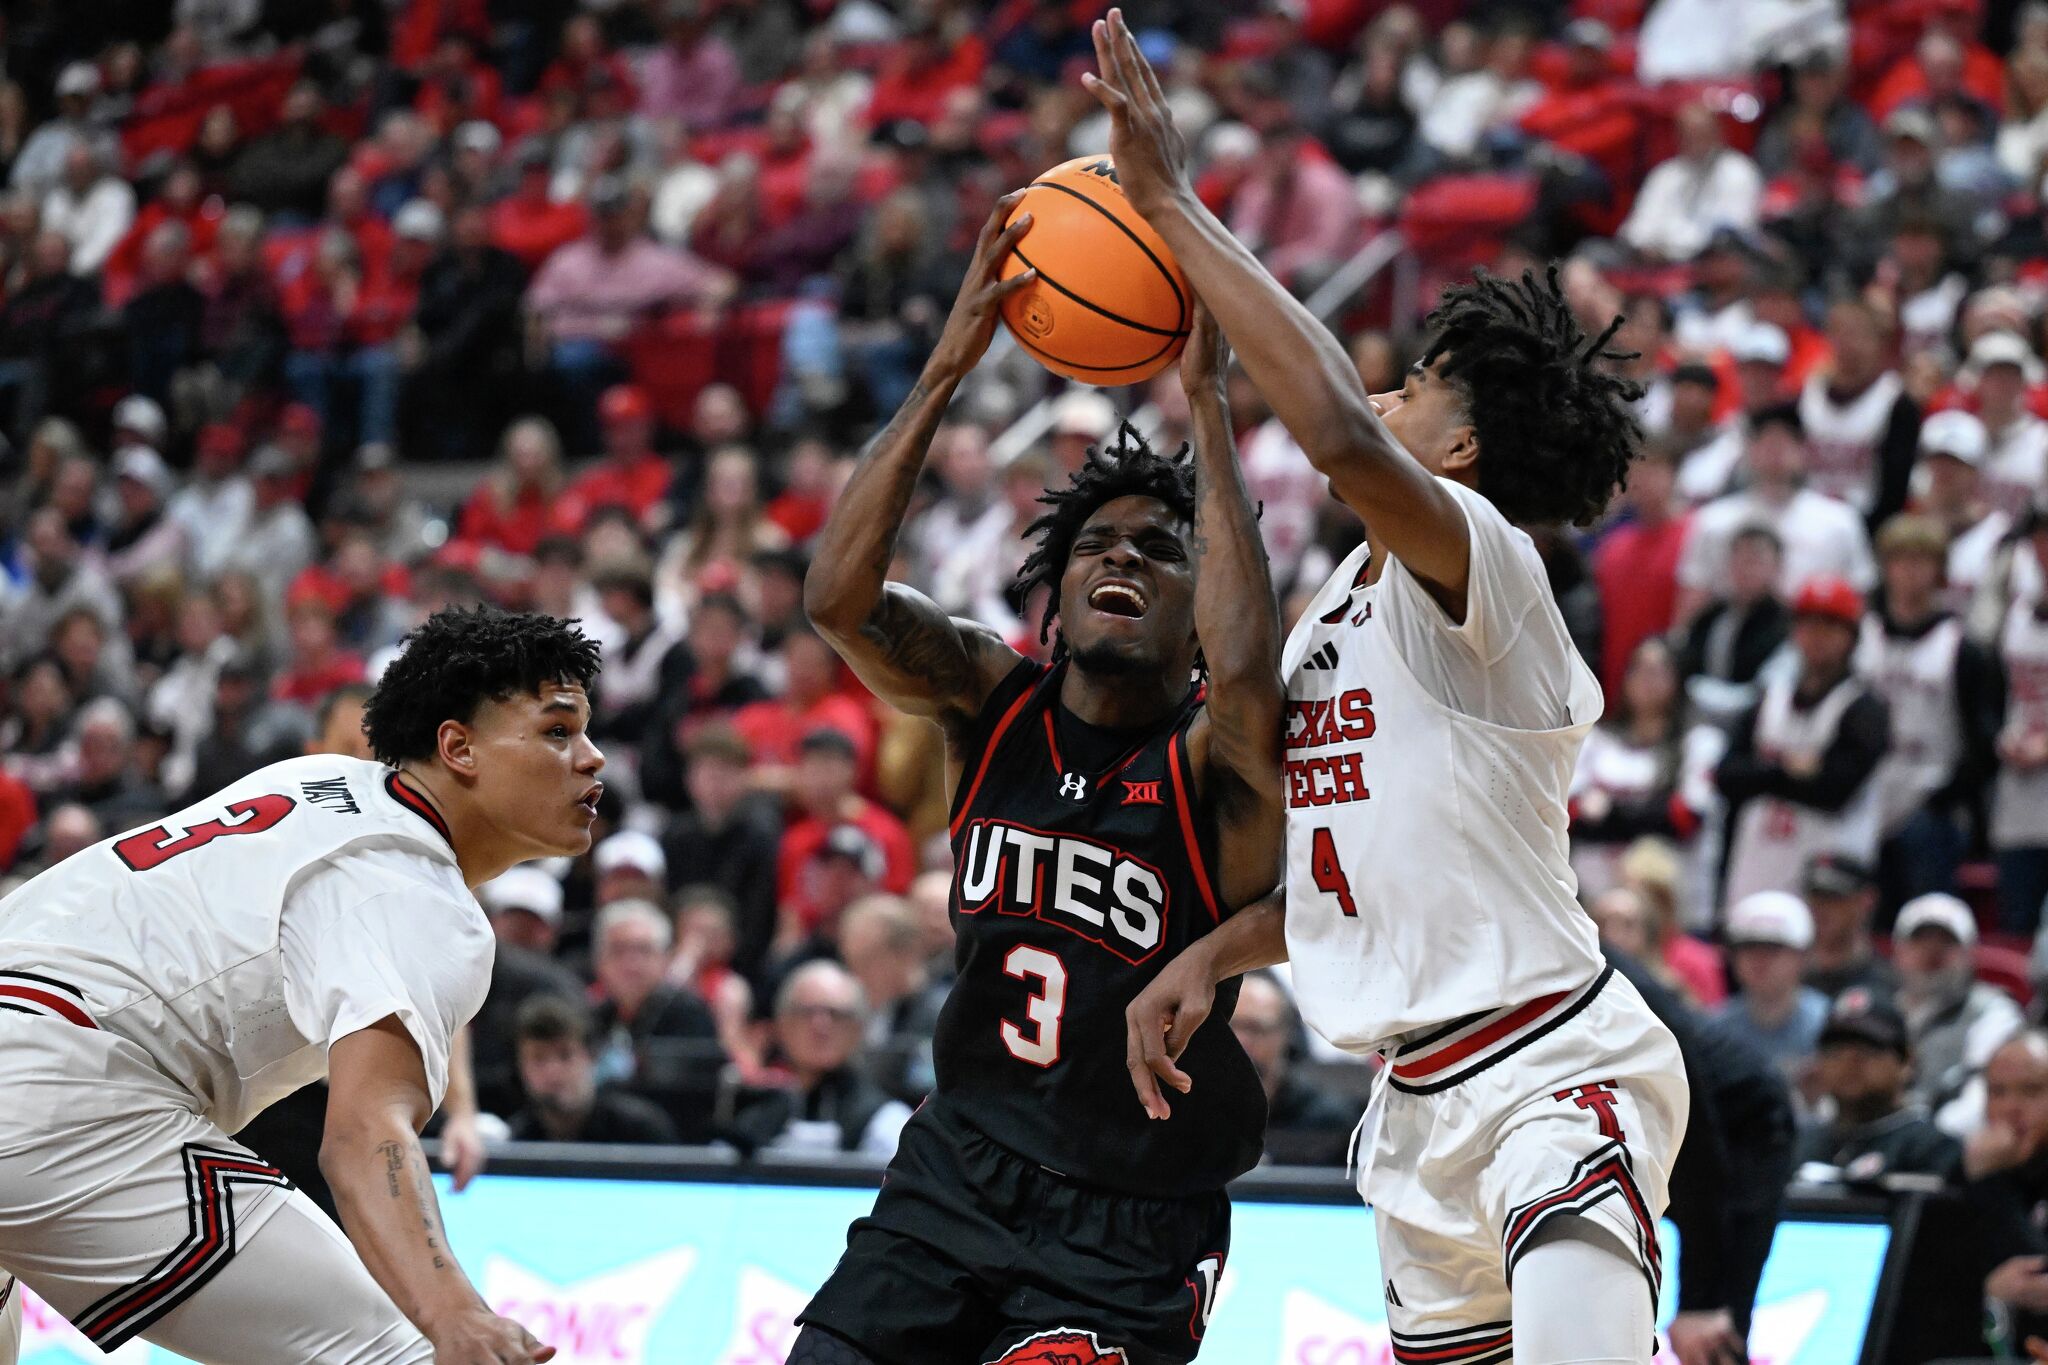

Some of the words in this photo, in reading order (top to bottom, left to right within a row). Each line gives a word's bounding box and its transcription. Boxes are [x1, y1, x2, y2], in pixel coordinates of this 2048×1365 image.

[1283, 687, 1377, 748] EXAS
[112, 793, 297, 872] 3
[1120, 780, 1164, 806] XII
[962, 823, 1164, 950] UTES
[1311, 827, 1358, 917] 4
[1000, 943, 1068, 1068] 3
